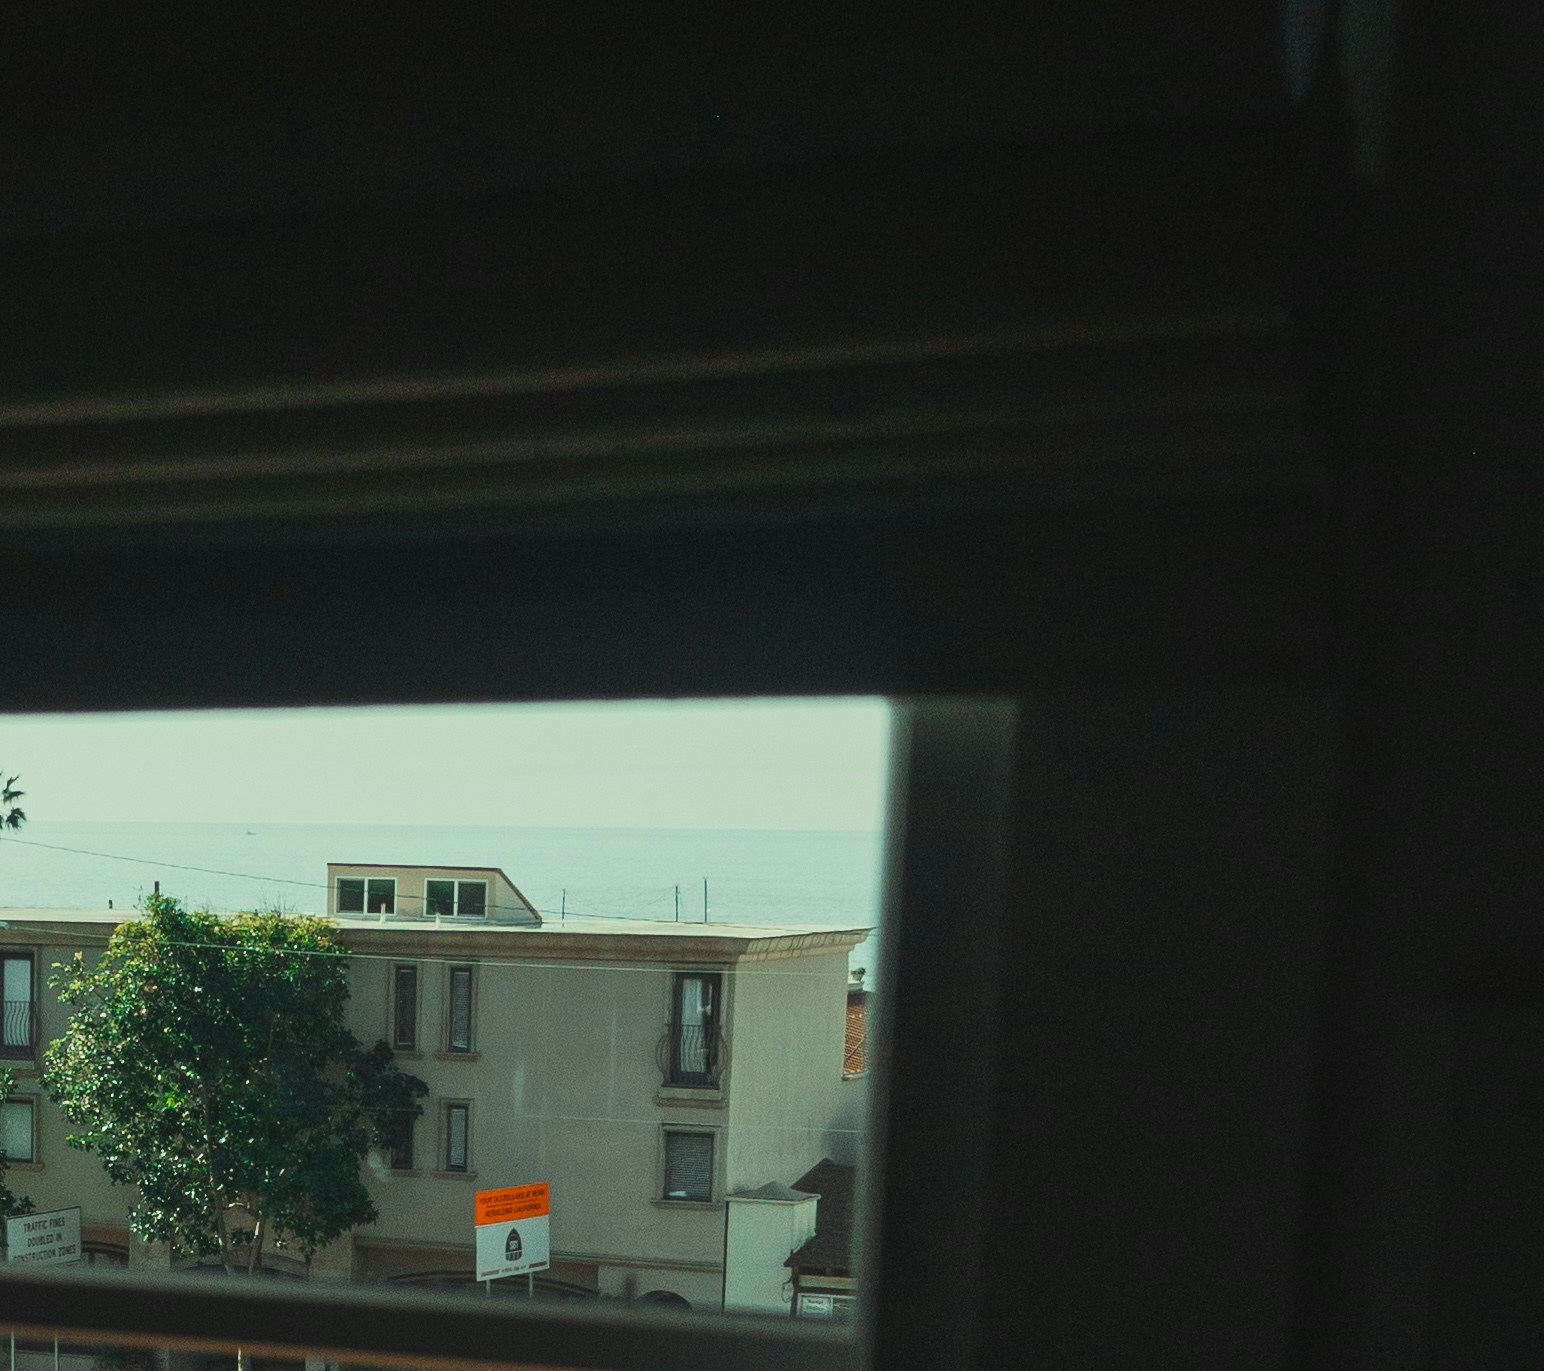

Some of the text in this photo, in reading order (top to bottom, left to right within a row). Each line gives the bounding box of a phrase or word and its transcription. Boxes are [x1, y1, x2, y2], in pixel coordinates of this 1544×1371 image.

[23, 1216, 66, 1234] TRAFFIC FINES
[27, 1232, 63, 1248] DOUBLED IN
[13, 1243, 76, 1262] CONSTRUCTION ZONES
